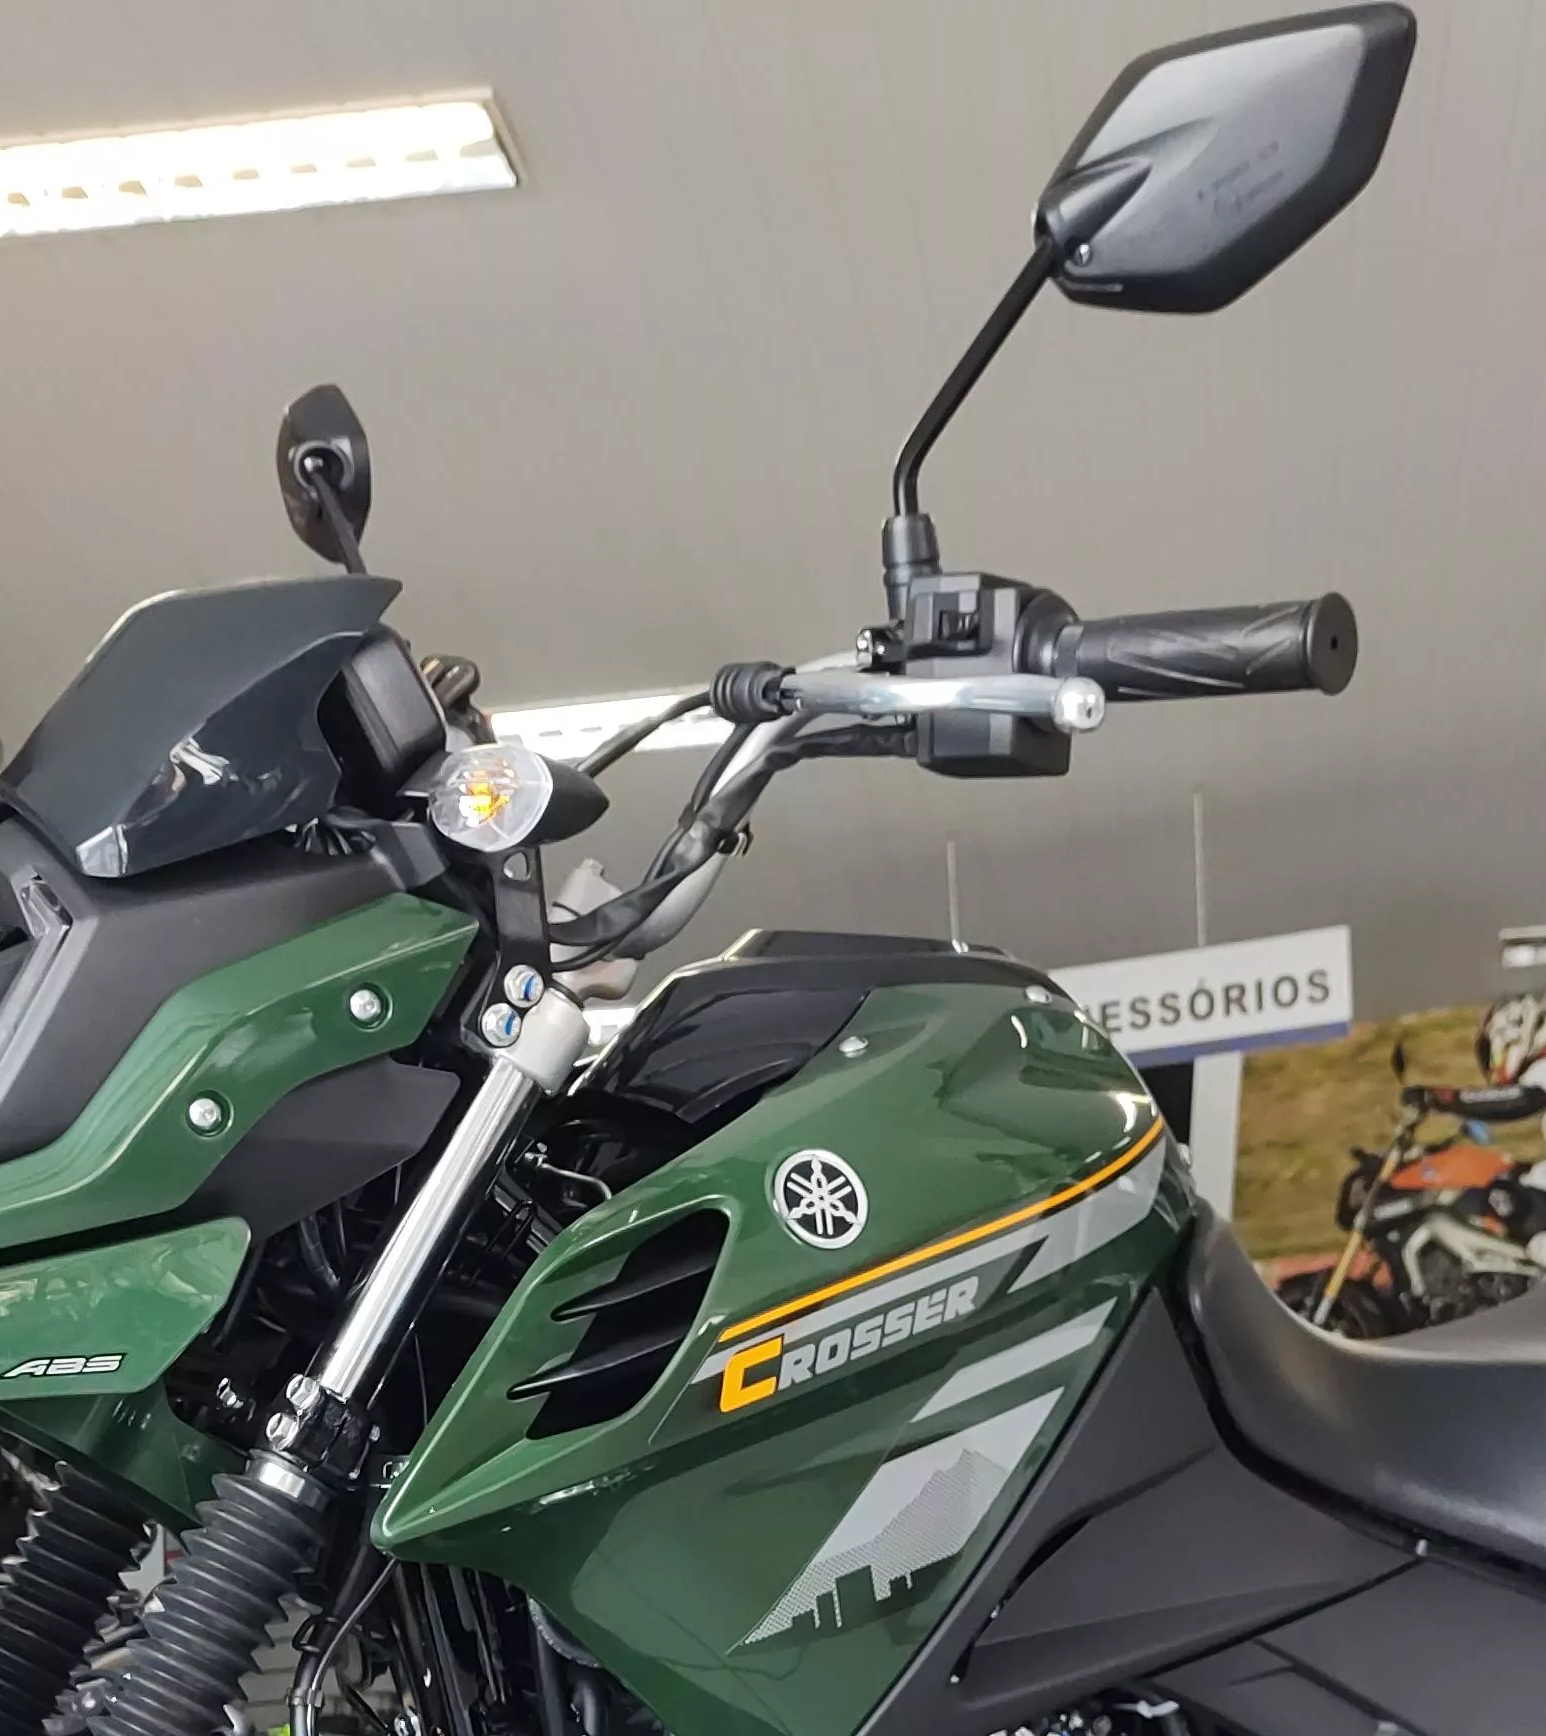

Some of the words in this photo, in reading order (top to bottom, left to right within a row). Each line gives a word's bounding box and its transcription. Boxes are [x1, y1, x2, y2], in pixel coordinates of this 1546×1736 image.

[1093, 968, 1331, 1035] ESSÓRIOS
[0, 1354, 124, 1378] ABS
[719, 1276, 979, 1412] CROSSER
